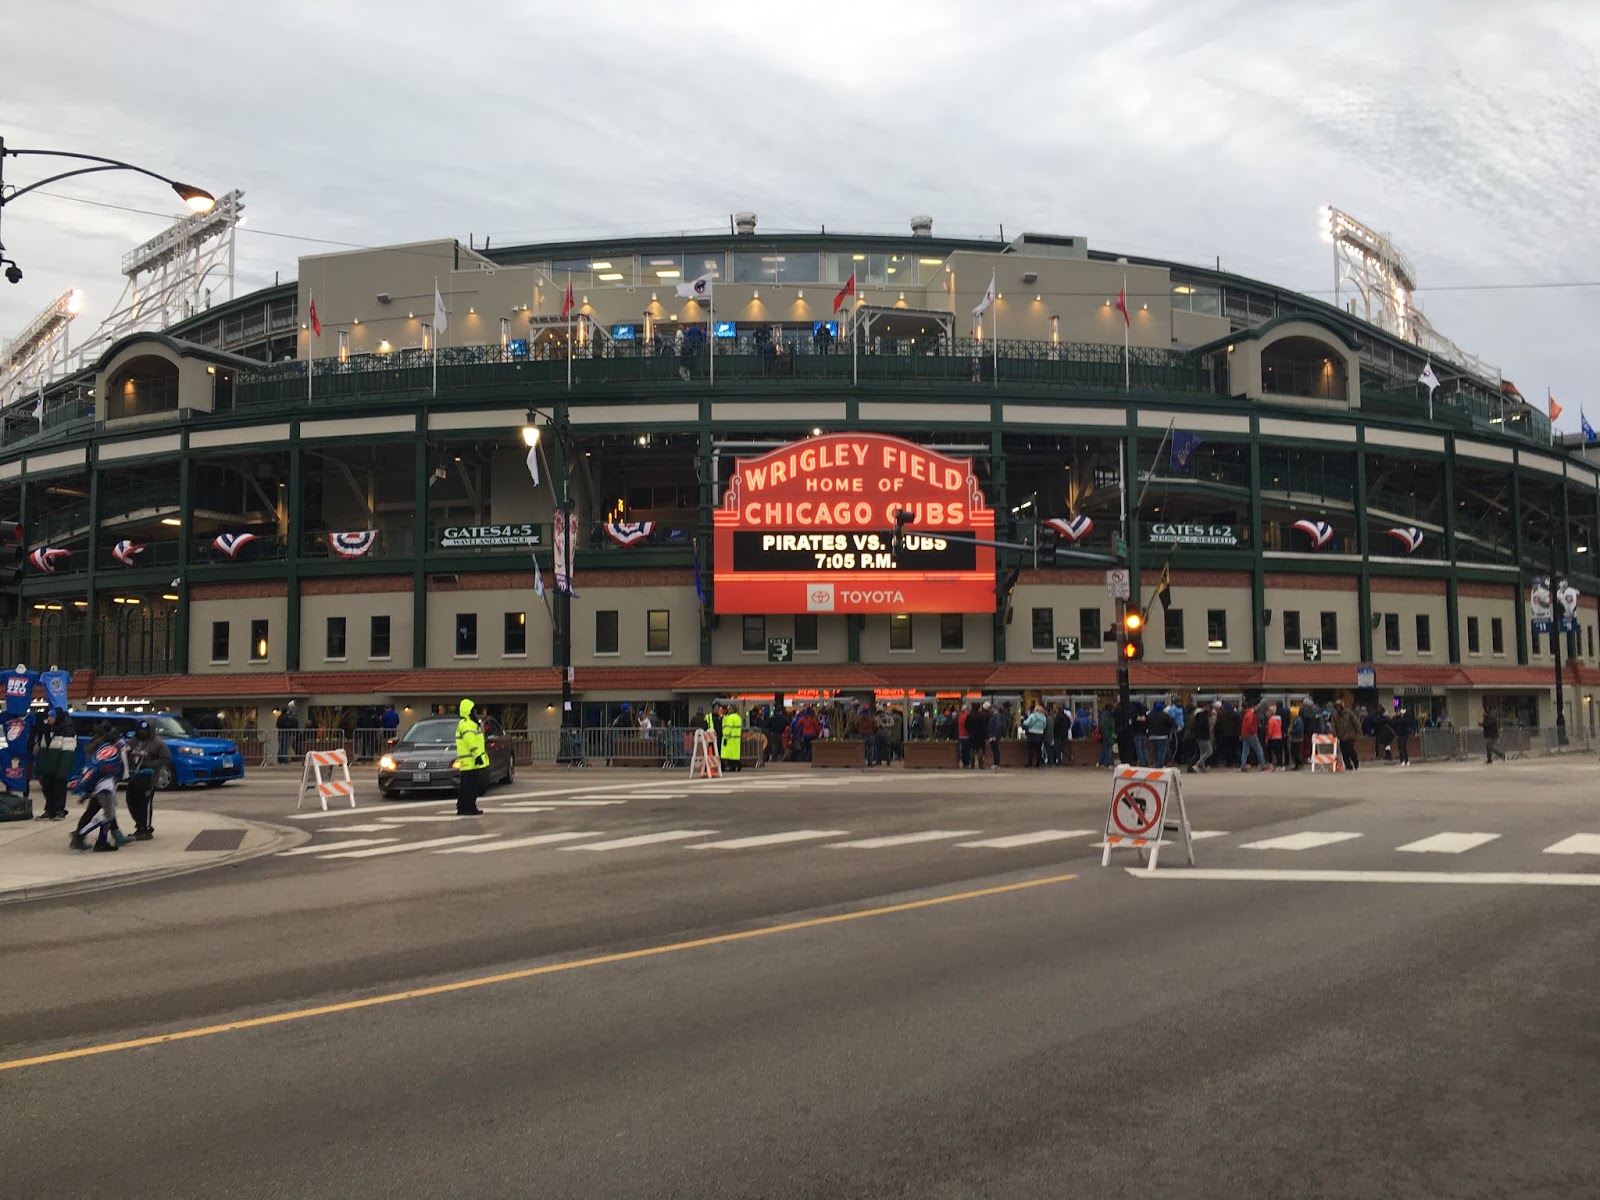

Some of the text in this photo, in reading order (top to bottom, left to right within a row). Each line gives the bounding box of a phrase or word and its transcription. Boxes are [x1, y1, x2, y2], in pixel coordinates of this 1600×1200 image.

[745, 443, 963, 492] WRIGLEY FIELD
[806, 477, 905, 492] HOME OF
[745, 502, 872, 525] CHICAGO
[444, 526, 501, 538] GATES
[1152, 523, 1204, 536] GATES
[762, 535, 947, 551] PIRATES VS. UBS
[815, 553, 897, 569] 7:05 P.M.
[840, 590, 905, 603] TOYOTA
[773, 643, 788, 657] 3
[1060, 642, 1075, 657] 3
[1306, 643, 1318, 657] 3
[6, 686, 27, 694] ZZO
[7, 679, 28, 687] BRY
